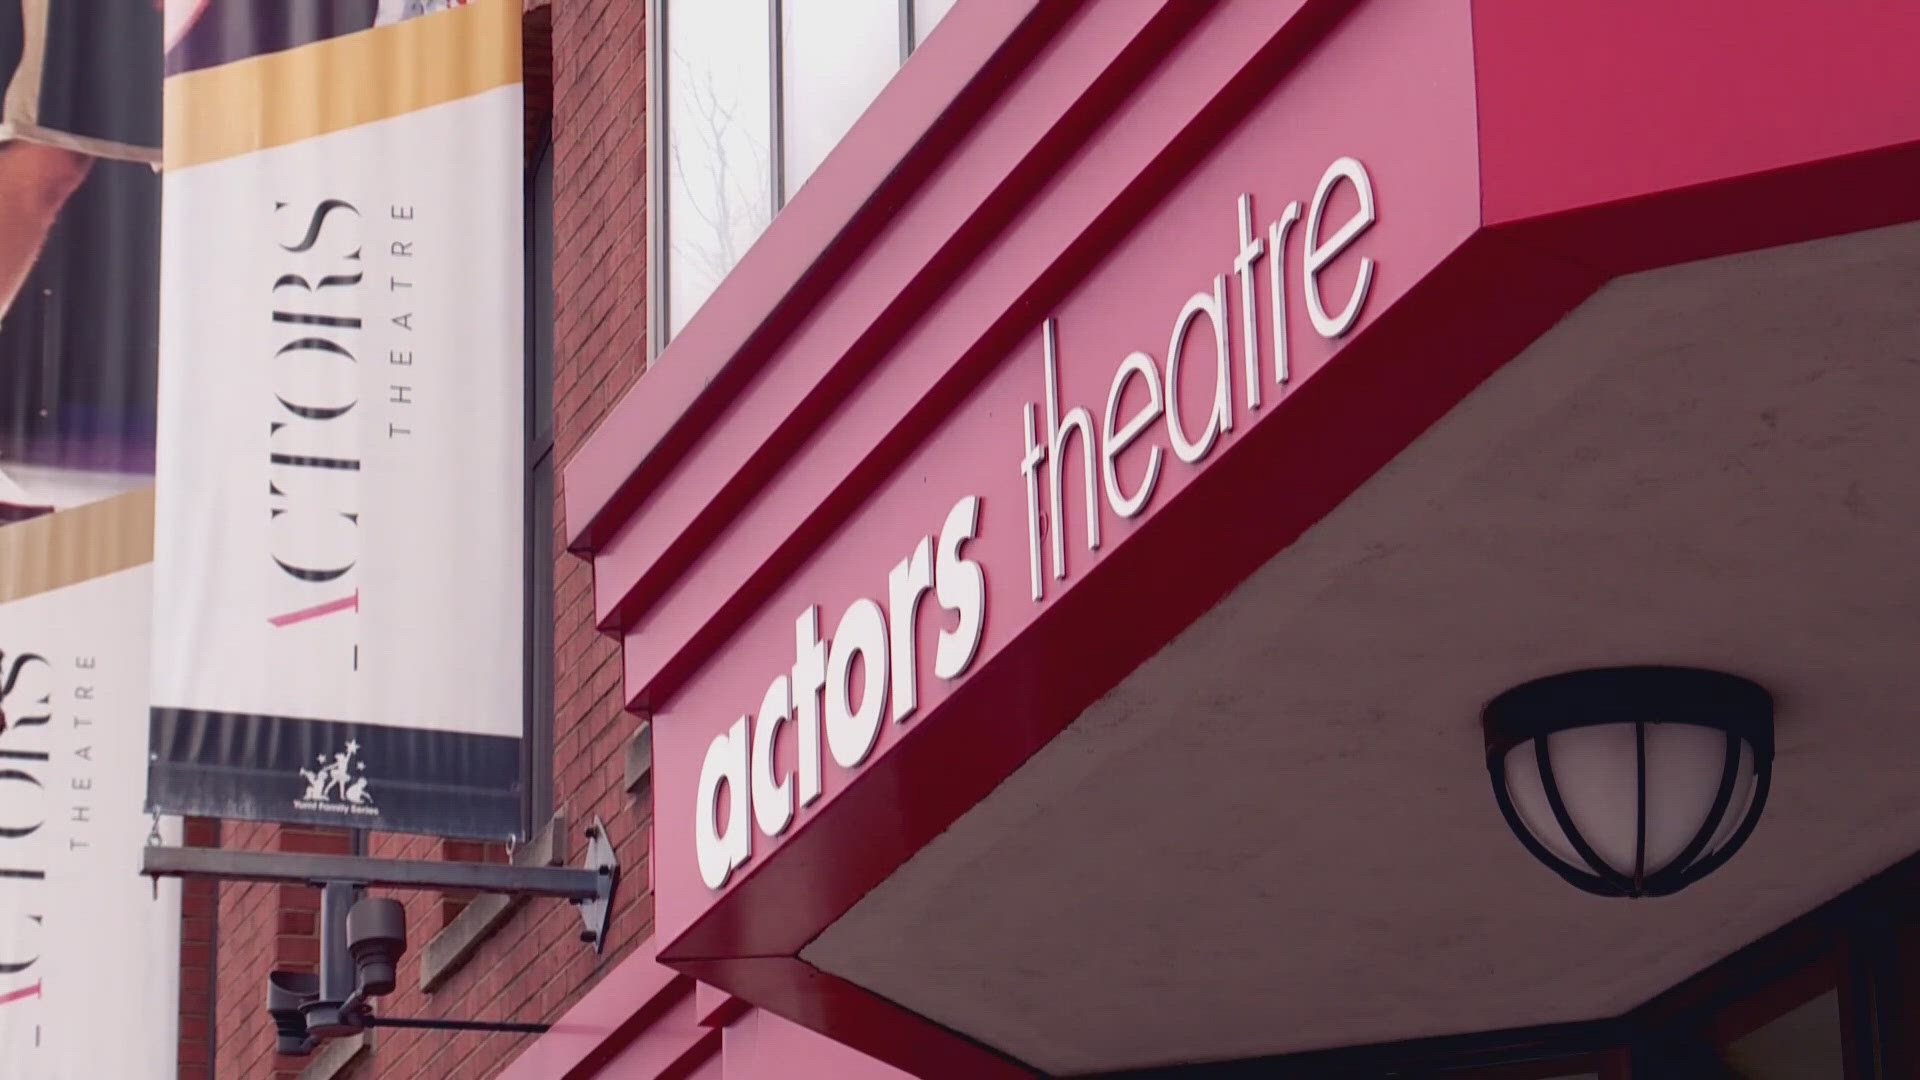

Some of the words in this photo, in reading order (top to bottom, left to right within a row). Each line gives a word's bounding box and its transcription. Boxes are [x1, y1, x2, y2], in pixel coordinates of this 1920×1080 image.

[267, 198, 363, 673] ACTORS
[387, 204, 414, 439] THEATRE
[696, 494, 985, 892] actors
[1021, 156, 1376, 602] theatre
[69, 655, 96, 852] THEATRE
[319, 802, 349, 815] Family
[351, 805, 378, 815] Series
